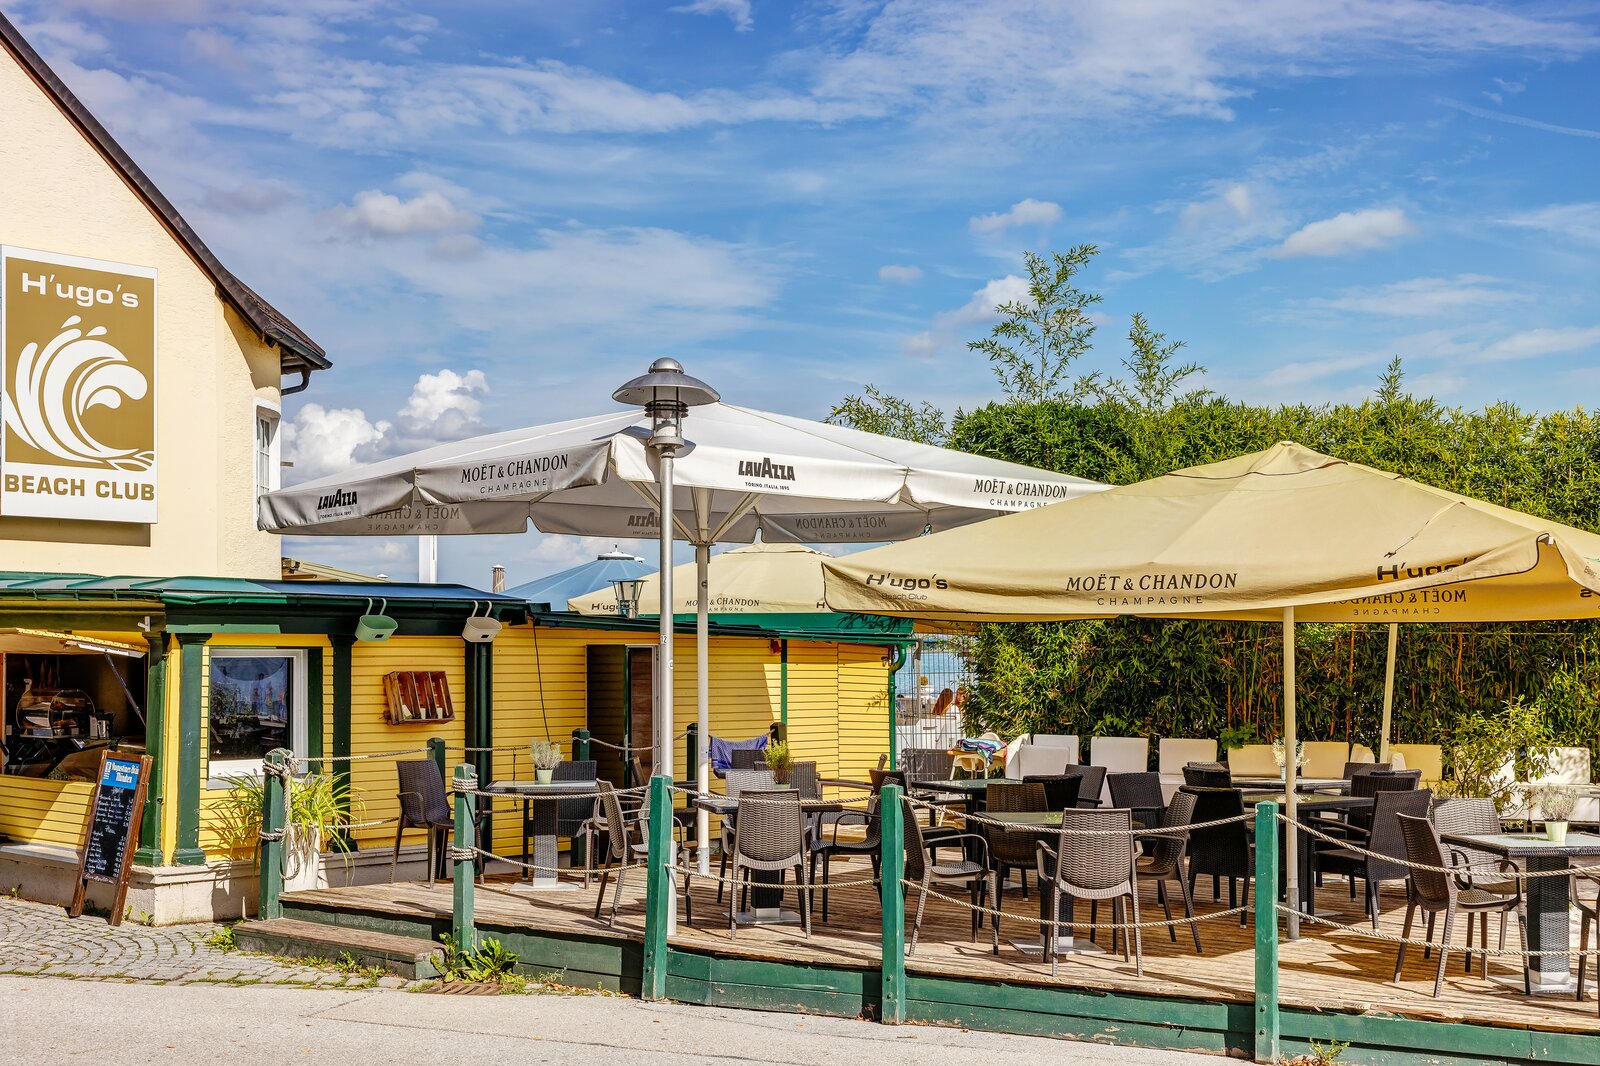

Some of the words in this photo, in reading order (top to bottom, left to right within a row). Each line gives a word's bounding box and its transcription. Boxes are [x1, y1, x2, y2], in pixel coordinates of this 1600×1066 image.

[21, 272, 139, 308] H'ugo's
[461, 463, 496, 483] MOËT
[497, 466, 505, 478] &
[507, 454, 568, 477] CHANDON
[738, 457, 796, 481] LAVAZZA
[4, 473, 85, 497] BEACH
[95, 479, 155, 501] CLUB
[480, 478, 547, 494] CHAMPAGNE
[973, 479, 1006, 494] MOËT
[1007, 484, 1014, 495] &
[1015, 482, 1068, 499] CHANDON
[317, 488, 358, 510] LAVAZZA
[866, 572, 948, 590] H'ugo's
[1066, 573, 1120, 591] MOËT
[1123, 578, 1134, 591] &
[1139, 573, 1238, 591] CHANDON
[716, 597, 760, 607] CHANDON
[1097, 596, 1203, 606] CHAMPAGNE
